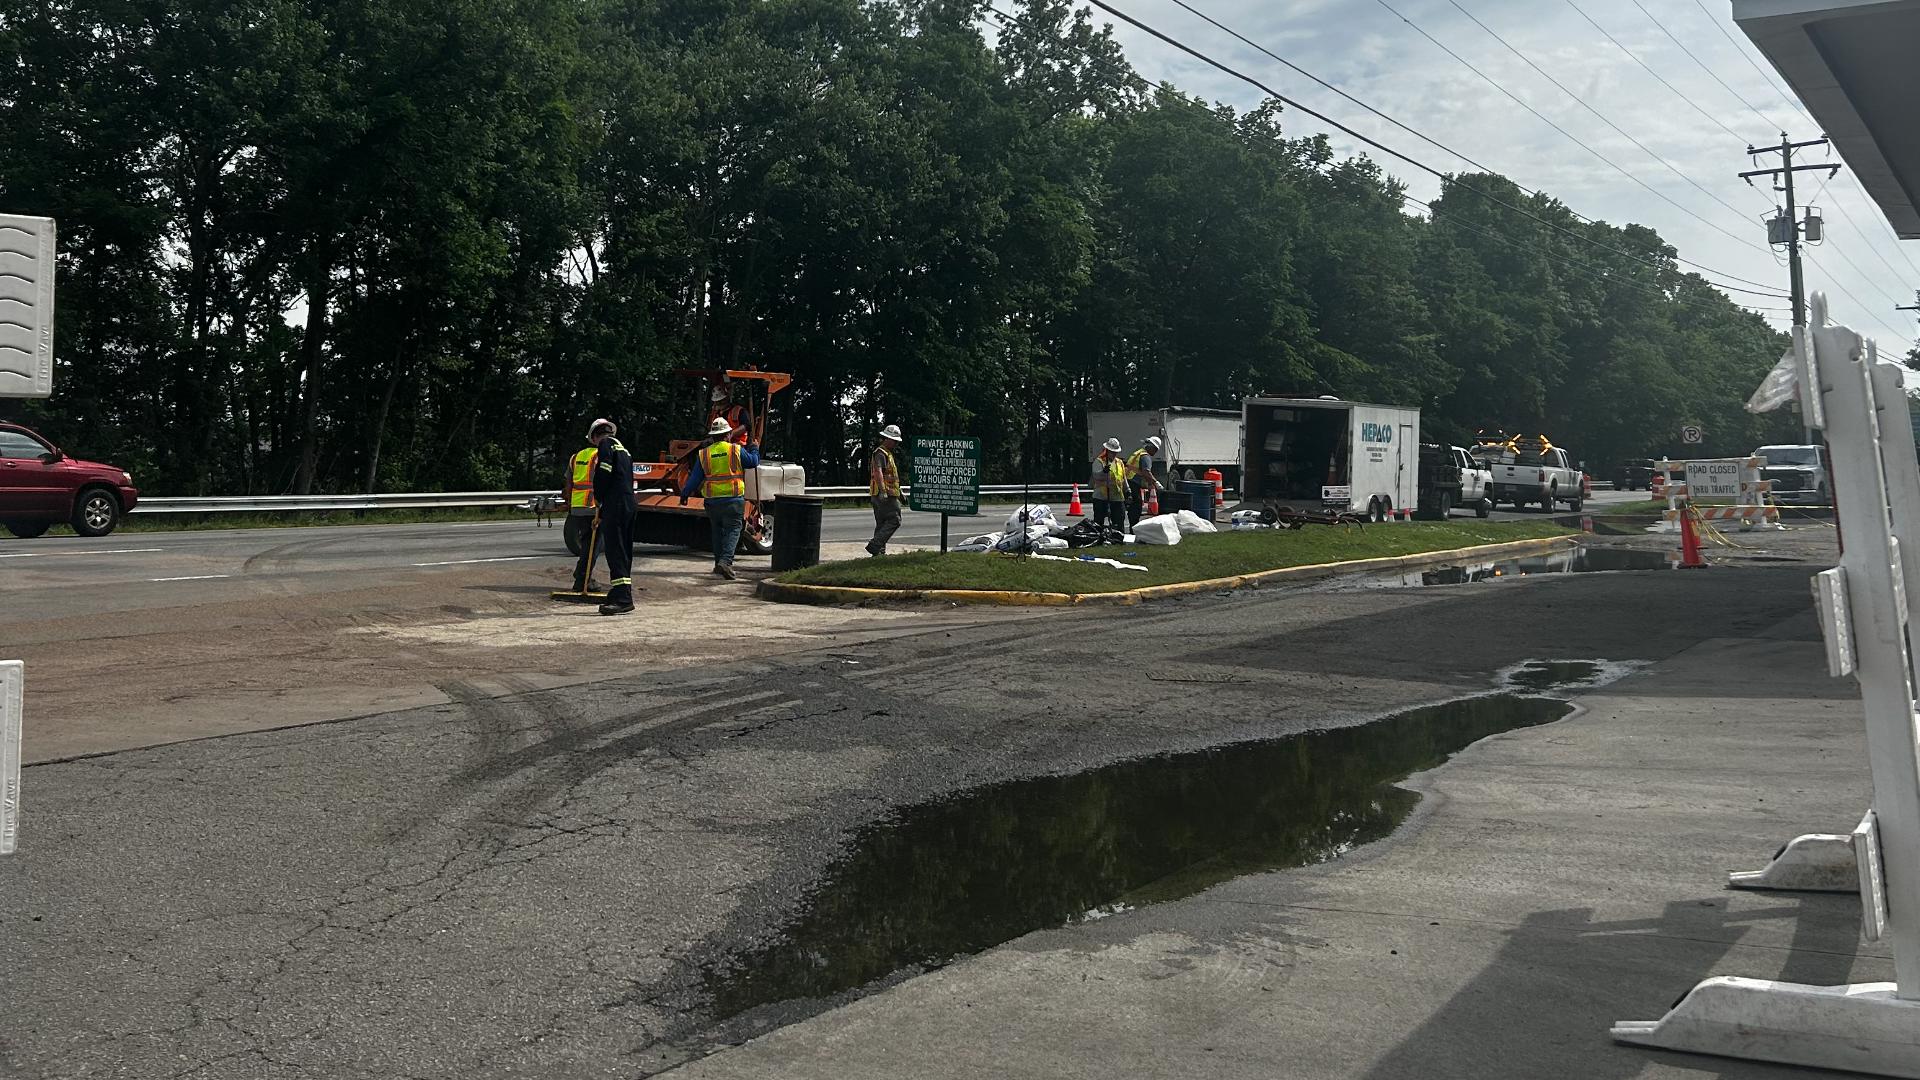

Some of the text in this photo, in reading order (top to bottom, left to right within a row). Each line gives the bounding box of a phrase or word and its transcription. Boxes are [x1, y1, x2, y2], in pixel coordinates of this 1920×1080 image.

[1361, 422, 1392, 443] HEPACO
[917, 439, 974, 450] PRIVATE PARKING
[930, 448, 964, 457] 7-ELEVEN
[914, 465, 977, 476] TOWING ENFORCED
[1687, 464, 1737, 474] ROAD CLOSED
[918, 474, 971, 485] 24 HOURS A DAY
[1709, 475, 1717, 483] TO
[1711, 484, 1736, 494] TRAFFIC
